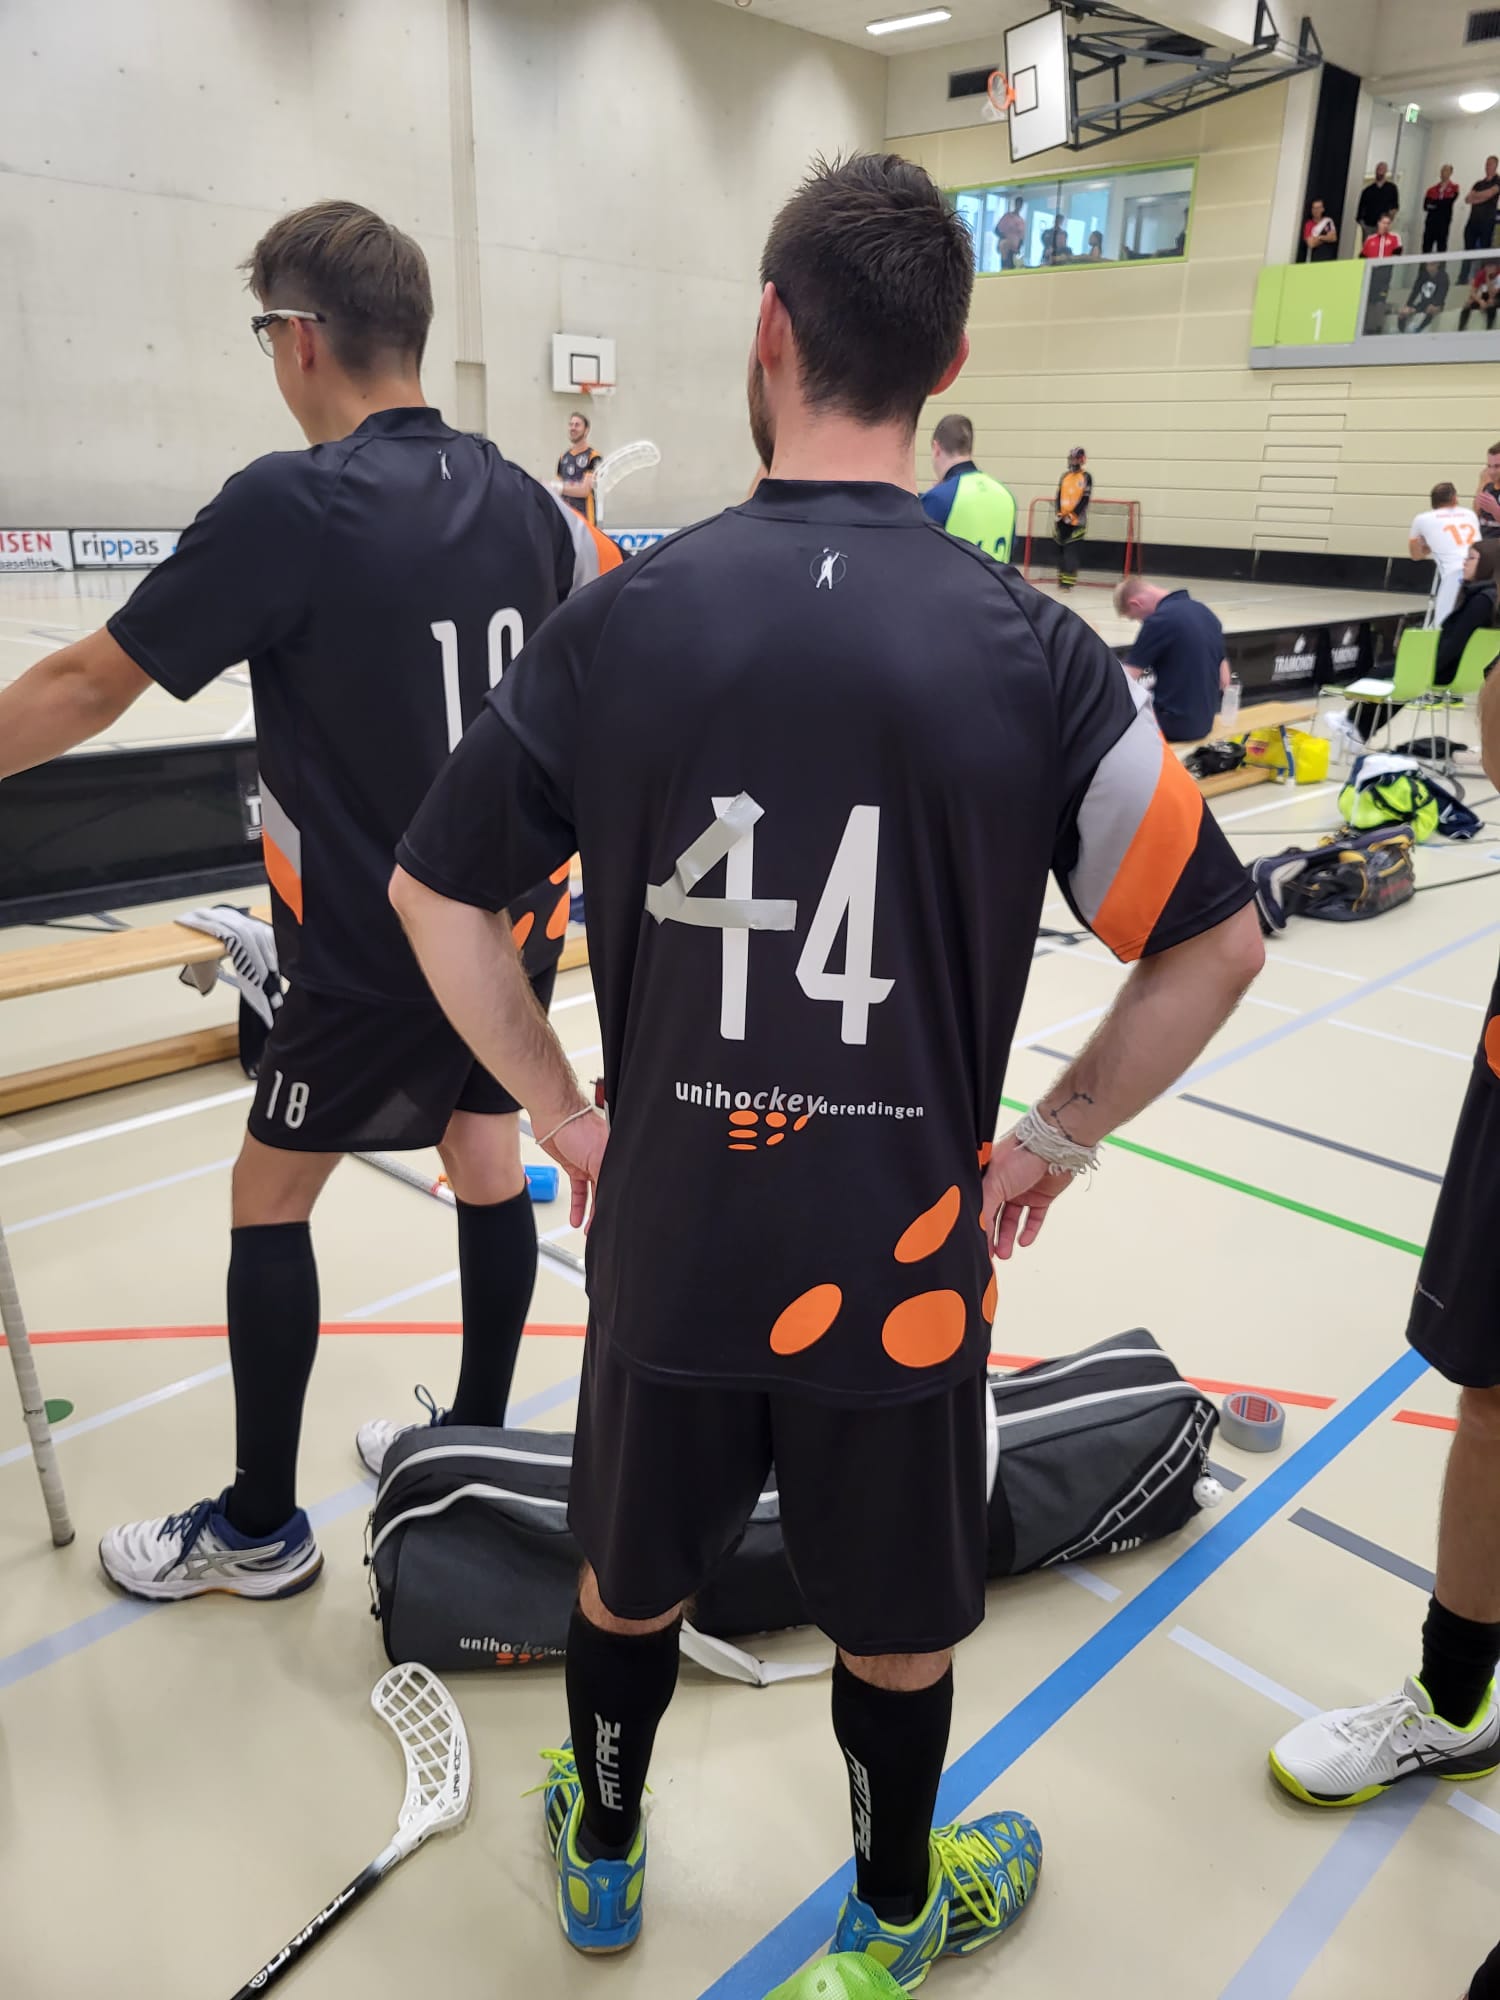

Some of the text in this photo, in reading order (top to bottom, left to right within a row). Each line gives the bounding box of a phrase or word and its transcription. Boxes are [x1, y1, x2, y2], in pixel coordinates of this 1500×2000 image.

[1311, 308, 1323, 341] 1
[82, 534, 159, 561] rippas
[644, 790, 897, 1046] 44
[266, 1069, 310, 1130] 18
